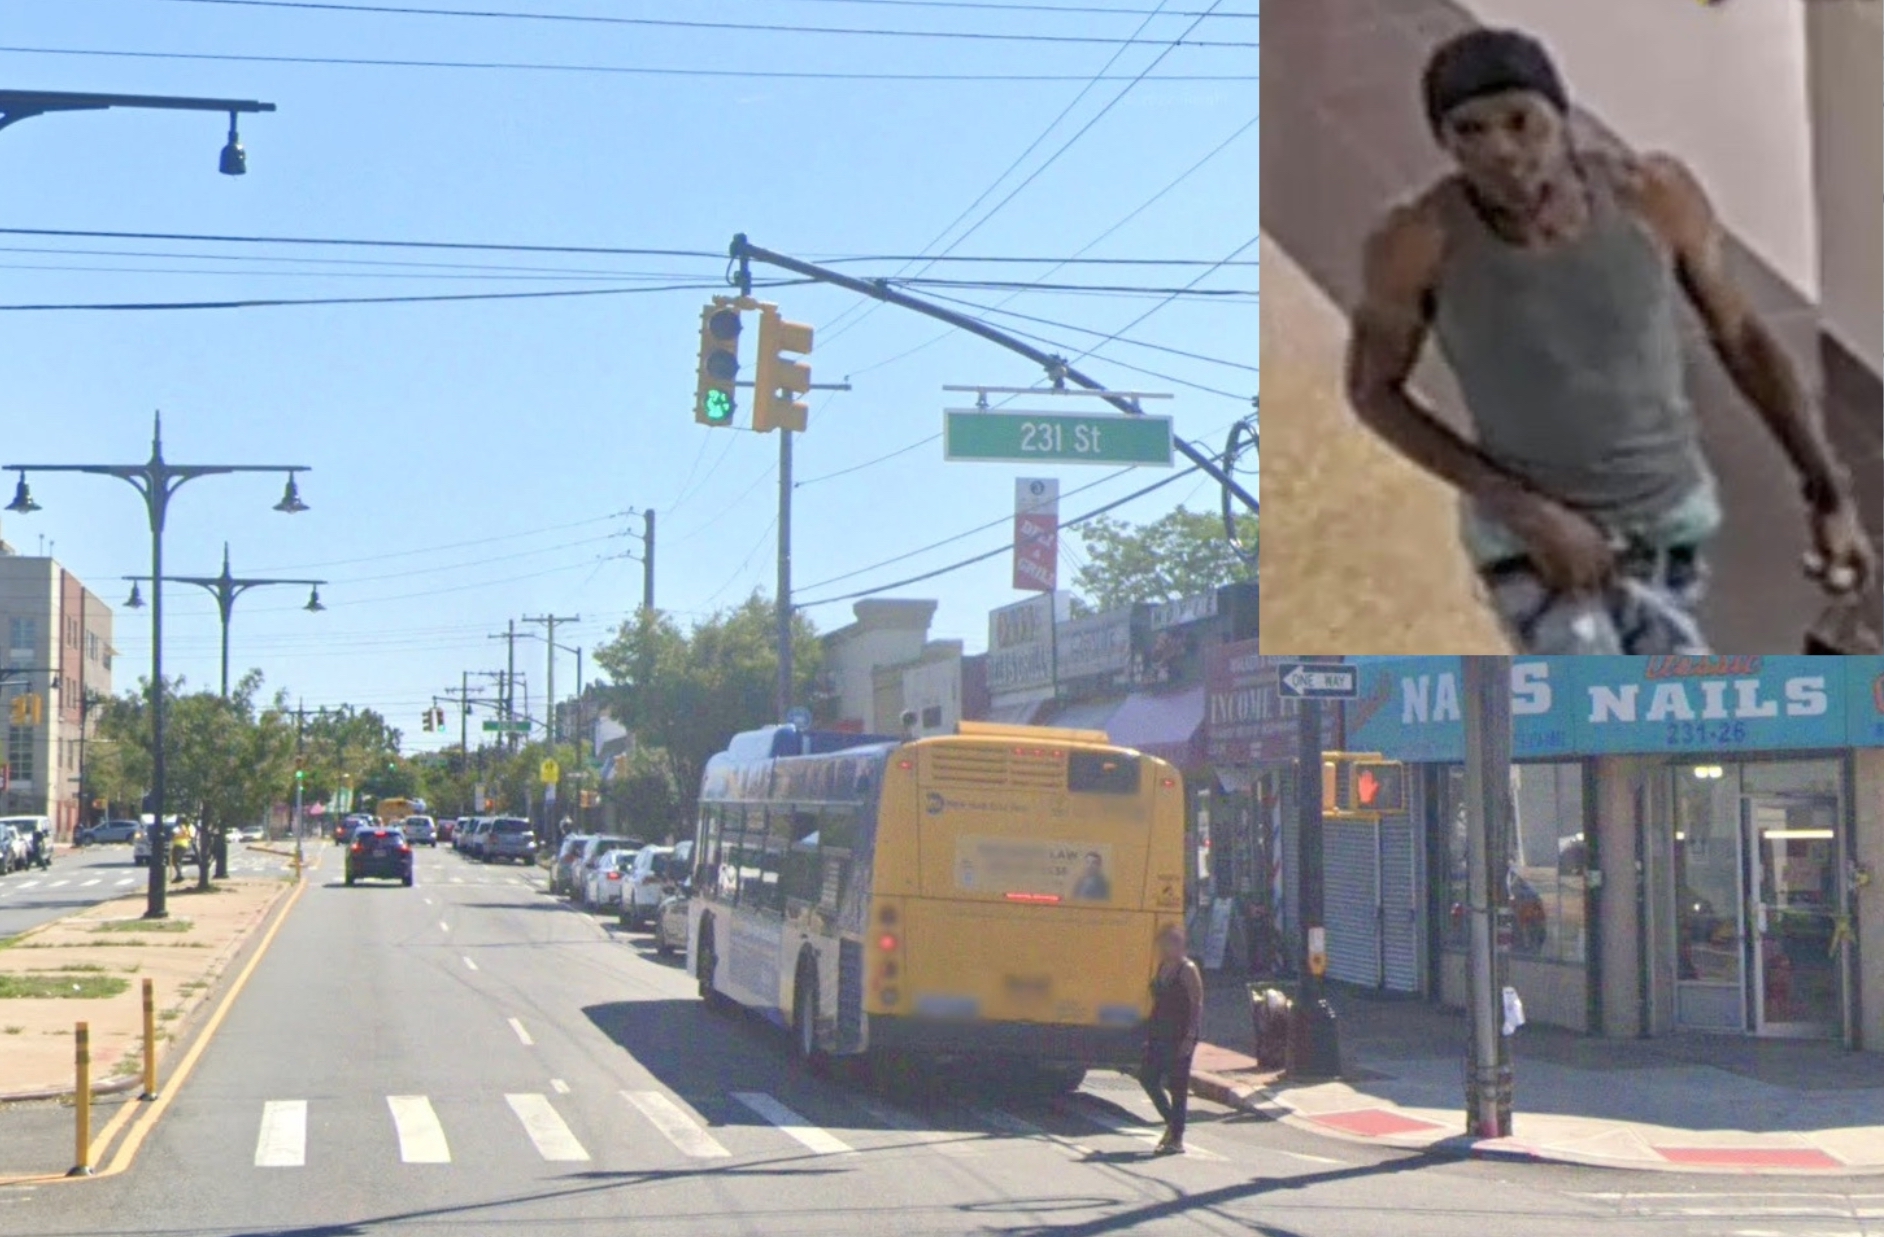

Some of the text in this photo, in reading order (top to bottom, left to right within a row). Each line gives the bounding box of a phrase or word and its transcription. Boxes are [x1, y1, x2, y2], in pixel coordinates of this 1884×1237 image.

[1021, 422, 1101, 453] 231 St
[1292, 673, 1346, 688] ONE WAY
[1401, 662, 1551, 724] NAS
[1588, 676, 1828, 723] NAILS
